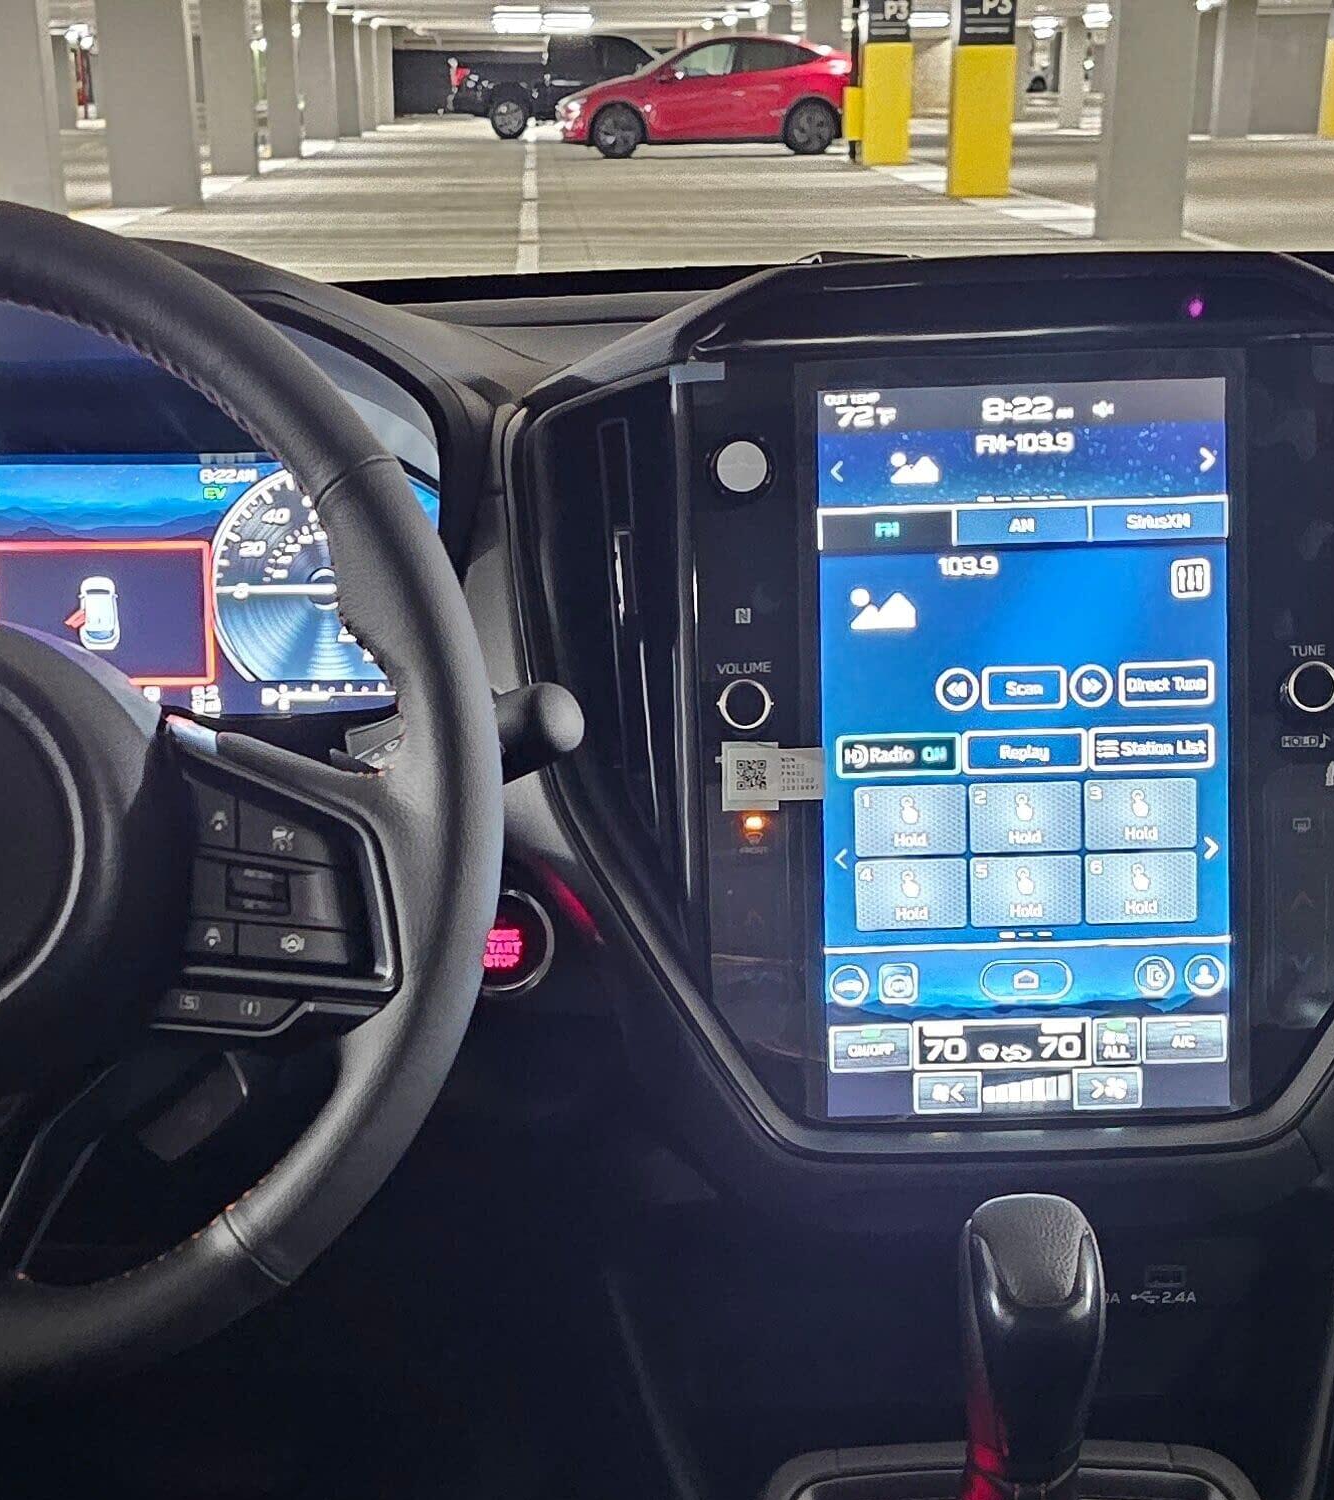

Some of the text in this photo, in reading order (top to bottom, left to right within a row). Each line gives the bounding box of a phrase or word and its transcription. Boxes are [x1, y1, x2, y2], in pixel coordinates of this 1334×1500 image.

[982, 396, 1054, 421] 8:22
[203, 486, 226, 500] EV
[261, 507, 290, 525] 40
[875, 521, 900, 537] FM
[1008, 517, 1035, 533] AM
[239, 540, 267, 557] 20
[938, 556, 999, 576] 103.9
[1289, 645, 1326, 657] TUNE
[717, 661, 771, 675] VOLUME
[1005, 681, 1044, 696] Scan
[1126, 676, 1207, 693] Direct Tune
[1120, 739, 1207, 756] Station List
[1282, 735, 1318, 747] HOLD
[870, 745, 915, 764] Radio
[999, 744, 1050, 762] Replay
[974, 790, 988, 805] 2
[1089, 785, 1103, 800] 3
[861, 794, 871, 808] 1
[894, 832, 928, 847] Hold
[1008, 830, 1042, 845] Hold
[1124, 826, 1159, 841] Hold
[859, 867, 873, 882] 4
[975, 864, 988, 878] 5
[1089, 860, 1103, 875] 6
[895, 906, 929, 921] Hold
[1009, 903, 1043, 918] Hold
[1124, 900, 1158, 914] Hold
[924, 1038, 967, 1062] 70
[1037, 1035, 1081, 1059] 70
[1162, 1291, 1197, 1303] 2.4A
